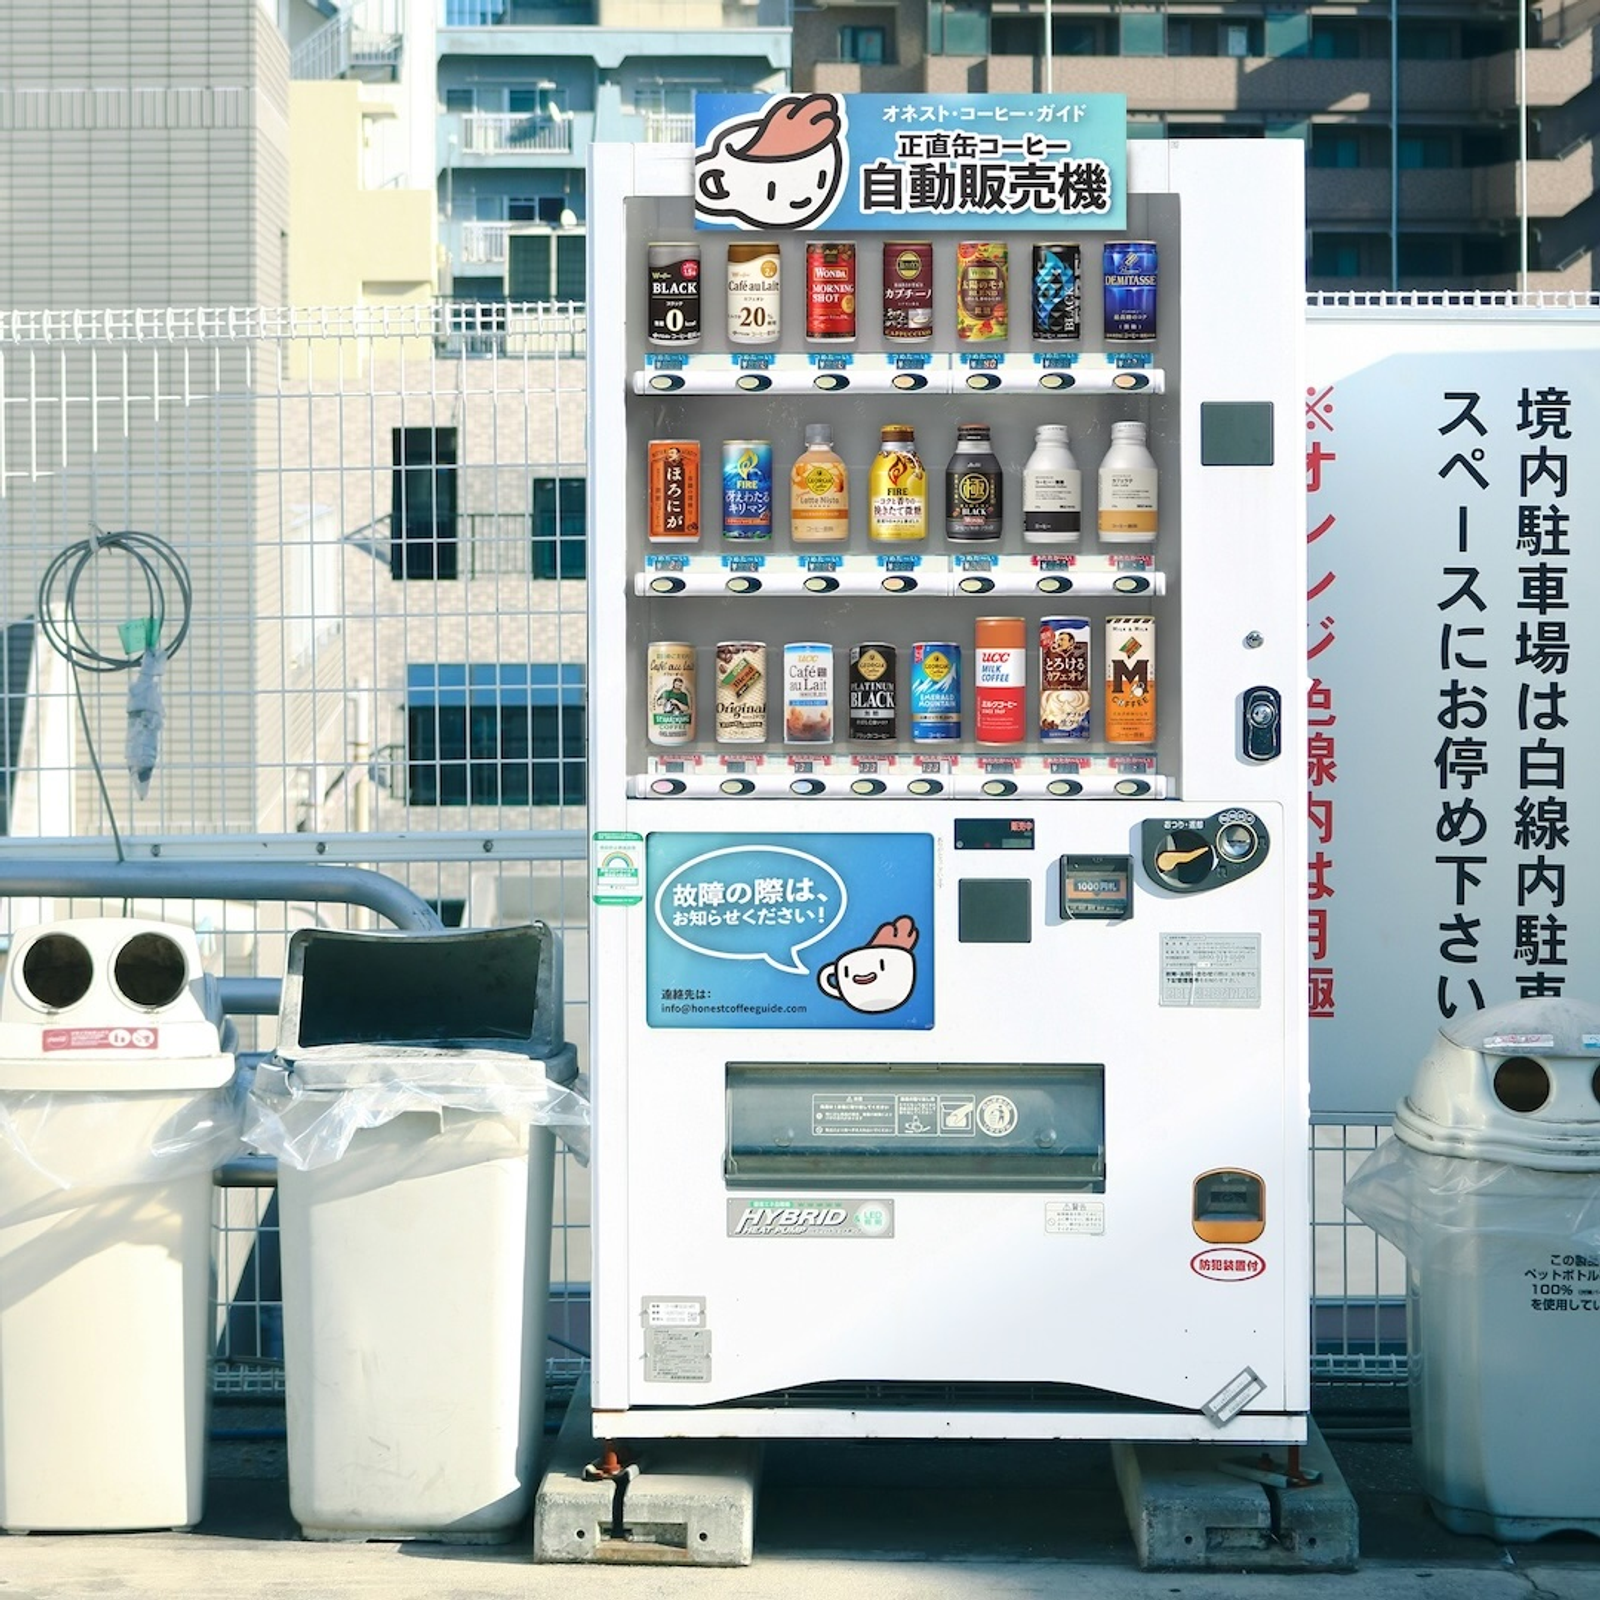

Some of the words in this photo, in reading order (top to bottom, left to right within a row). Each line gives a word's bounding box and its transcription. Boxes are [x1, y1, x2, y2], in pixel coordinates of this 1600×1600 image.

[882, 104, 1086, 123] オネスト・コーヒー・ガイド
[898, 133, 1069, 159] 正直缶コーヒー
[862, 162, 1108, 211] 自動販売機
[728, 280, 748, 292] Café
[748, 283, 761, 292] au
[761, 280, 780, 292] Lait
[1105, 275, 1156, 286] DEMITASSE
[652, 282, 697, 294] BLACK
[812, 284, 854, 293] MORNING
[812, 293, 840, 303] SHOT
[1064, 287, 1074, 331] BLACK
[666, 309, 684, 332] 0
[740, 306, 766, 327] 20
[736, 480, 758, 489] FIRE
[963, 479, 985, 499] 極
[666, 467, 684, 528] ほろにが
[887, 487, 908, 496] FIRE
[728, 503, 767, 514] キリマン
[962, 507, 987, 515] BLACK
[981, 652, 1010, 663] UCC
[1045, 657, 1086, 670] とろける
[789, 665, 816, 678] Café
[981, 665, 1002, 673] MILK
[981, 673, 1009, 682] COFFEE
[1047, 671, 1084, 682] カフェオレ
[1112, 659, 1149, 693] M
[789, 681, 802, 691] au
[804, 678, 827, 691] Lait
[850, 682, 894, 691] PLATINUM
[850, 691, 895, 708] BLACK
[1434, 392, 1489, 1019] スペースにお停め下さい
[716, 702, 766, 719] Original
[672, 877, 829, 907] 故障の際は、
[661, 1003, 807, 1015] info@honestcoffeeguide.com
[735, 1208, 849, 1230] HYBRID
[864, 1210, 882, 1219] LED
[1199, 1259, 1258, 1272] 防犯装置付
[1531, 1284, 1573, 1296] 100%
